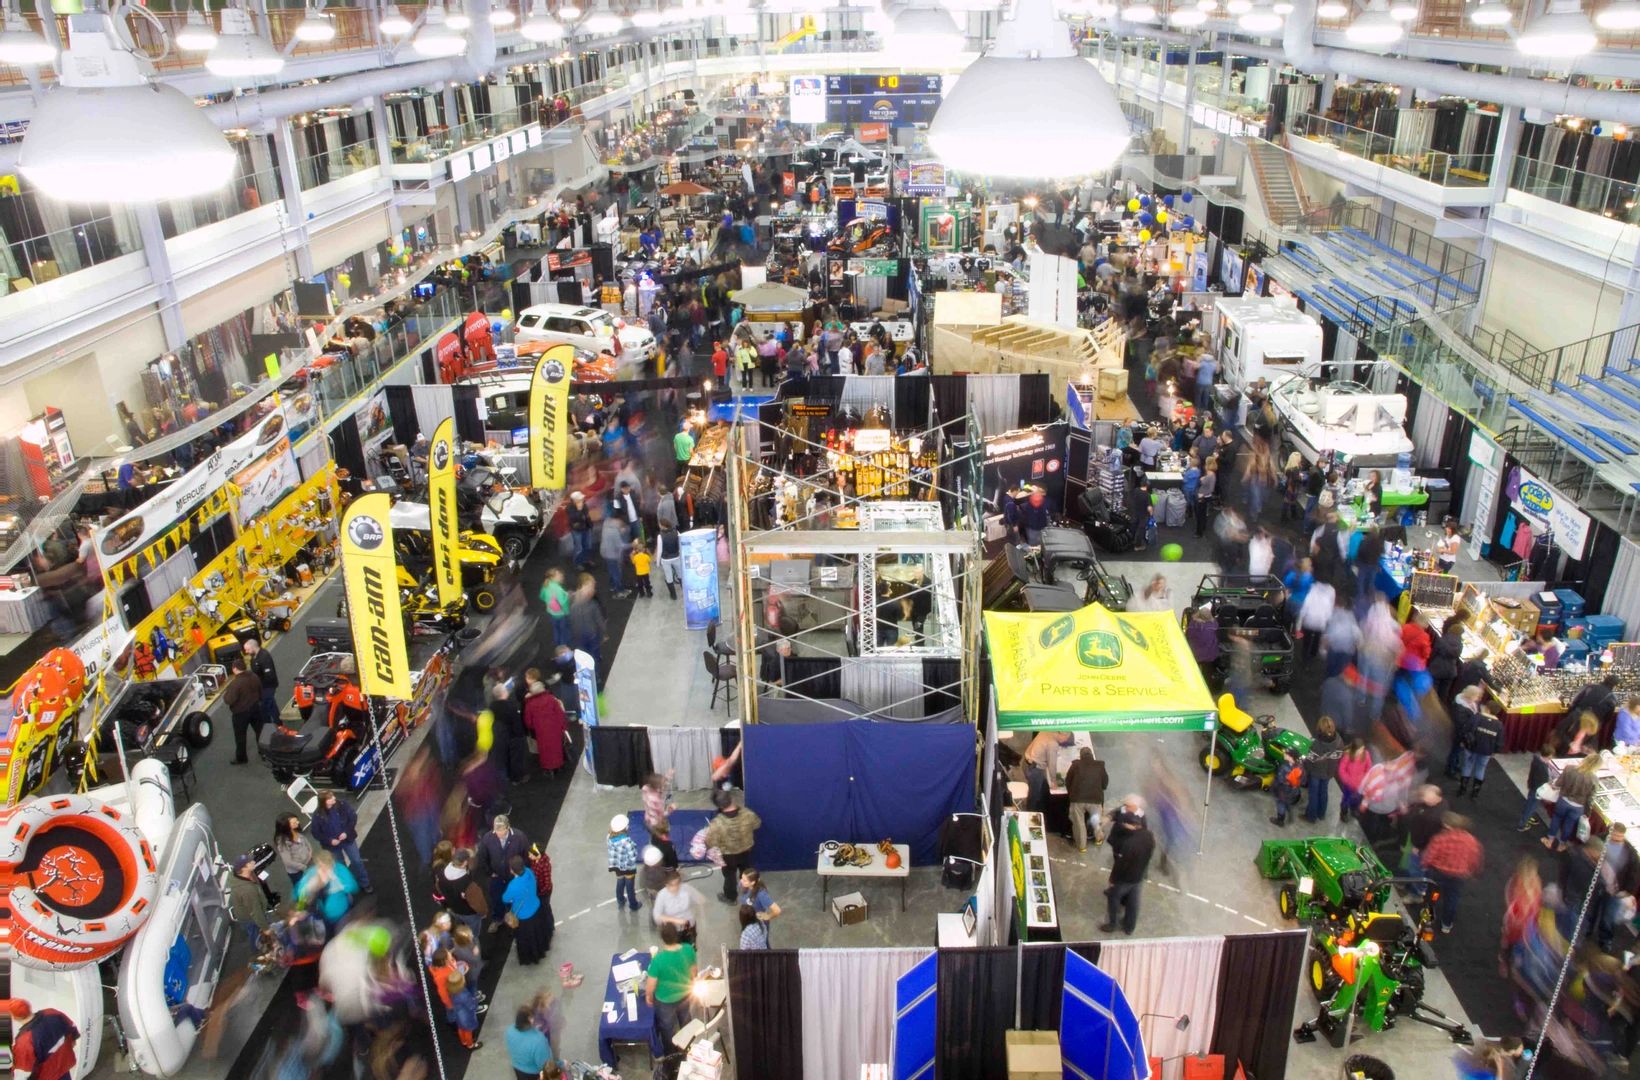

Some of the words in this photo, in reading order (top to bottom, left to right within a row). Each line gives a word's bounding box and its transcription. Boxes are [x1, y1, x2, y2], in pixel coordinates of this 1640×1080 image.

[469, 318, 489, 332] TOYOTA
[443, 339, 460, 355] TOYOTA
[543, 394, 556, 480] can-am
[175, 481, 209, 514] MERCURY
[362, 533, 383, 541] BRP
[363, 565, 394, 685] can-am
[1041, 683, 1088, 696] PARTS
[1092, 687, 1100, 696] &
[1105, 684, 1168, 696] SERVICE
